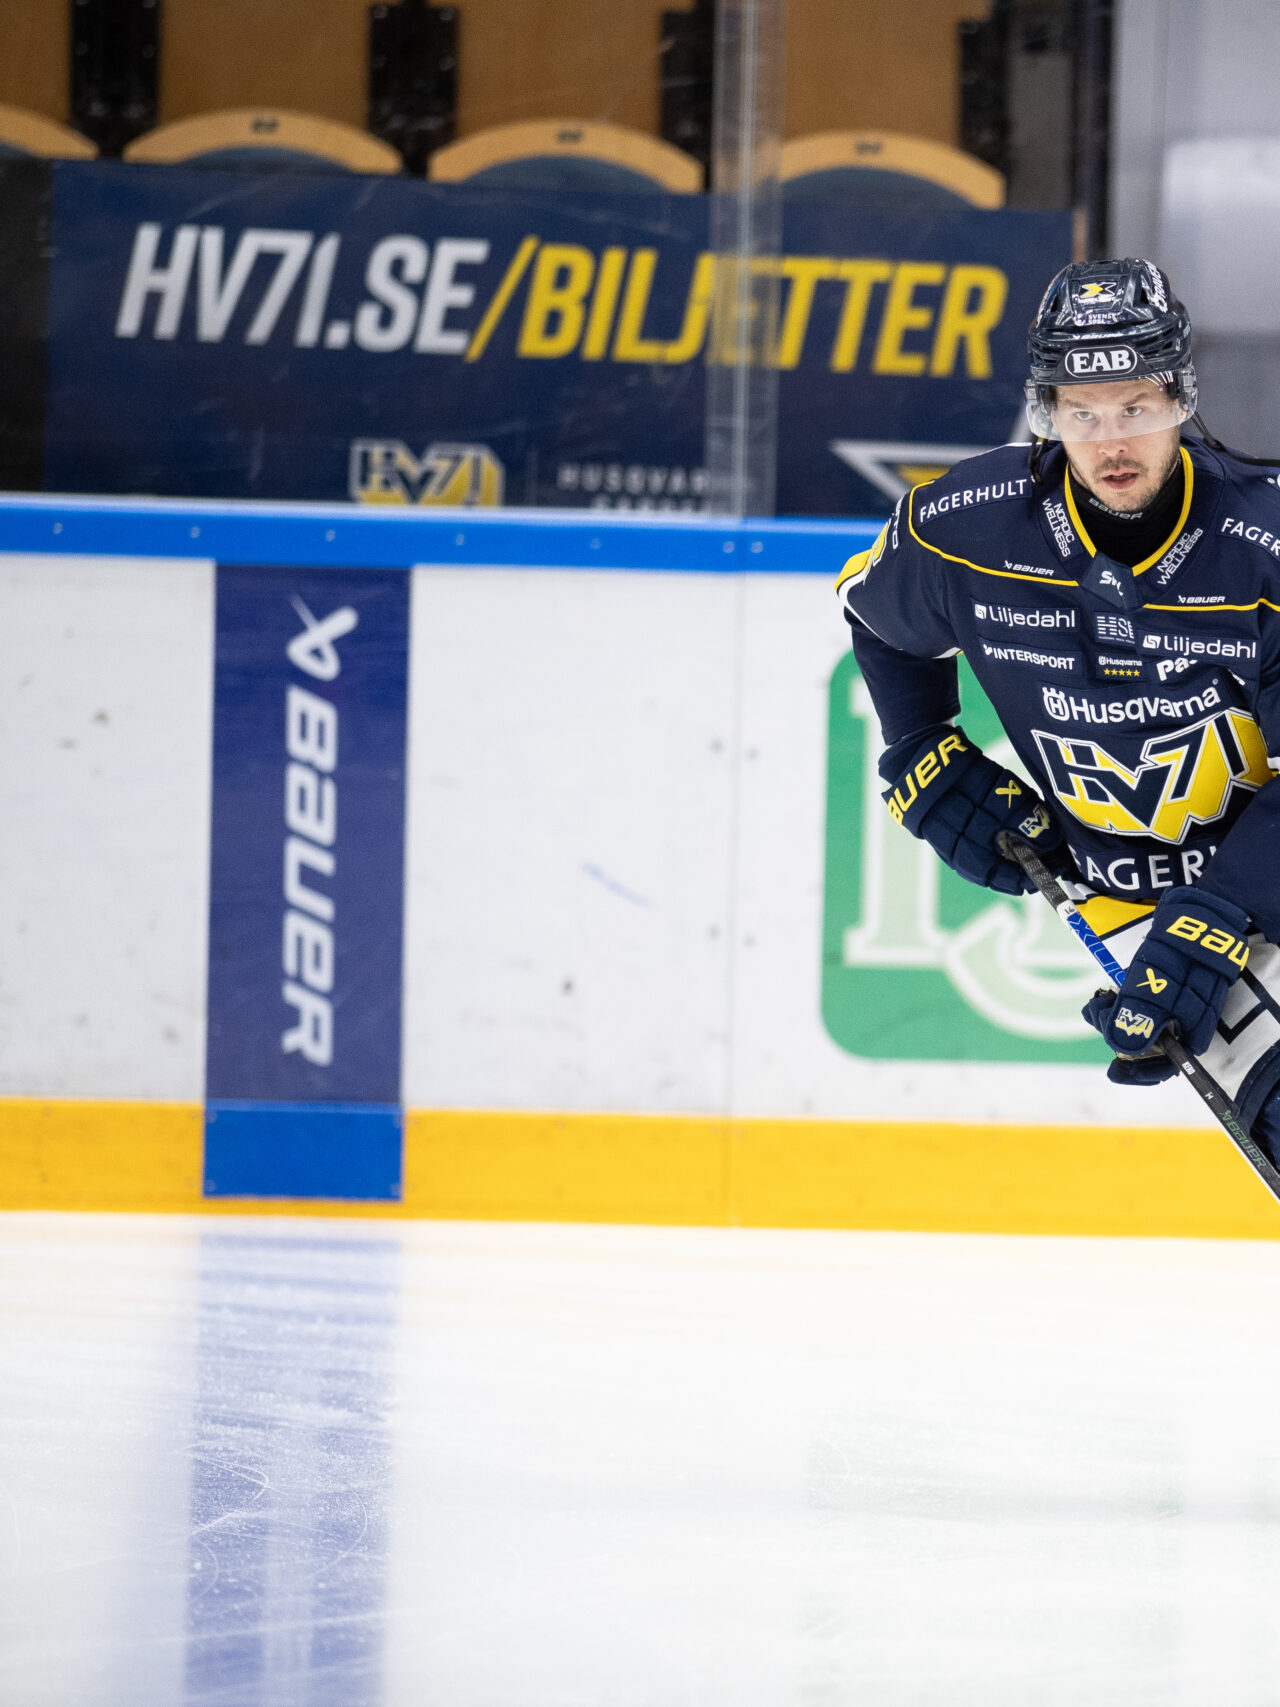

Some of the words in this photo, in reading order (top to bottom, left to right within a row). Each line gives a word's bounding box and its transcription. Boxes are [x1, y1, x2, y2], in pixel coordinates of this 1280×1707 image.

[1073, 350, 1132, 374] EAB
[556, 462, 712, 496] HUSQVAR
[919, 479, 1028, 524] FAGERHULT
[1042, 497, 1071, 558] WELLNESS
[1053, 502, 1075, 543] NORDIC
[1157, 532, 1190, 573] NORDIC
[1157, 527, 1204, 585] WELLNESS
[988, 605, 1076, 628] Liljedahl
[993, 647, 1076, 671] INTERSPORT
[1105, 657, 1143, 667] Husqvarna
[1163, 635, 1257, 659] Liljedahl
[1068, 685, 1222, 724] Husqvarna
[1031, 706, 1268, 845] HV71
[281, 684, 338, 1067] BAUER
[1067, 840, 1217, 891] AGER
[1166, 914, 1250, 972] BAU
